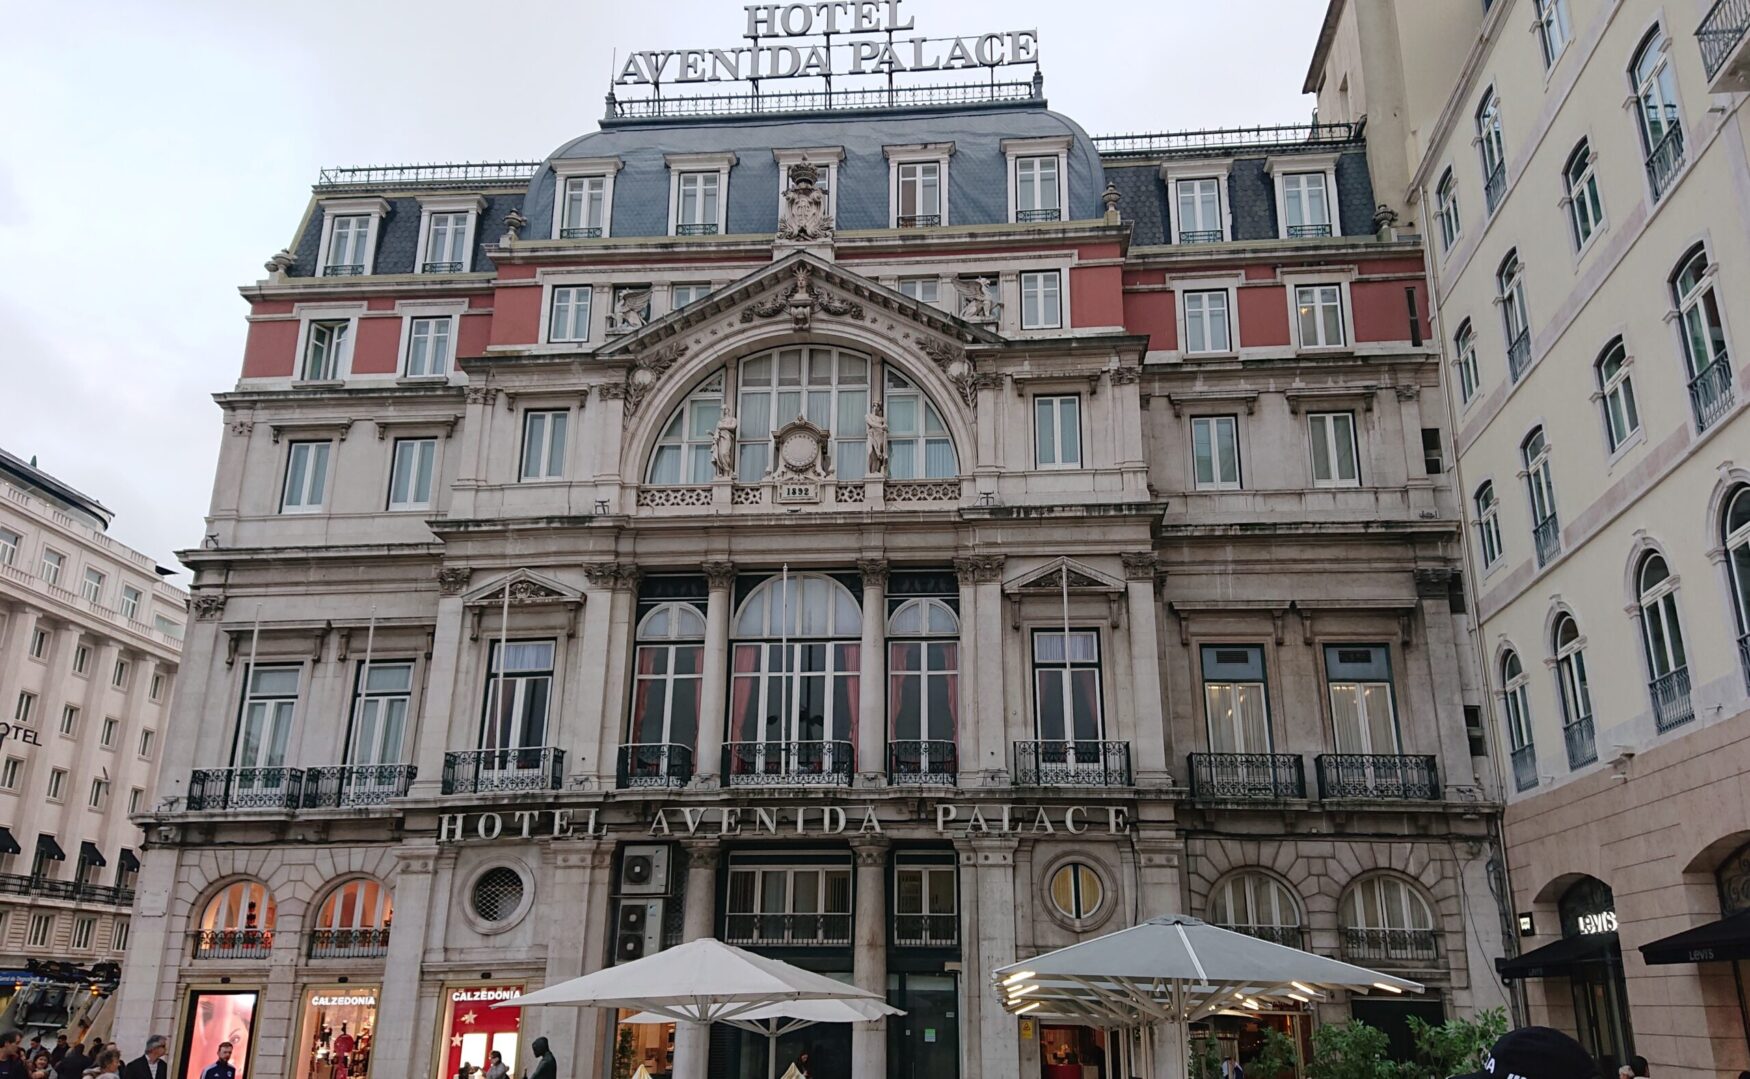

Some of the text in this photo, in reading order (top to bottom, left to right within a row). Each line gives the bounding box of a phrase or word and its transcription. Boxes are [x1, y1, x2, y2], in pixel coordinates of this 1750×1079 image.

[743, 0, 915, 38] HOTEL
[614, 29, 1039, 86] AVENIDA PALACE
[786, 487, 810, 496] 1892
[437, 803, 1132, 842] HOTEL AVENIDA PALACE
[311, 995, 376, 1006] CALZEDONIA
[451, 990, 522, 1002] CALZEDONIA
